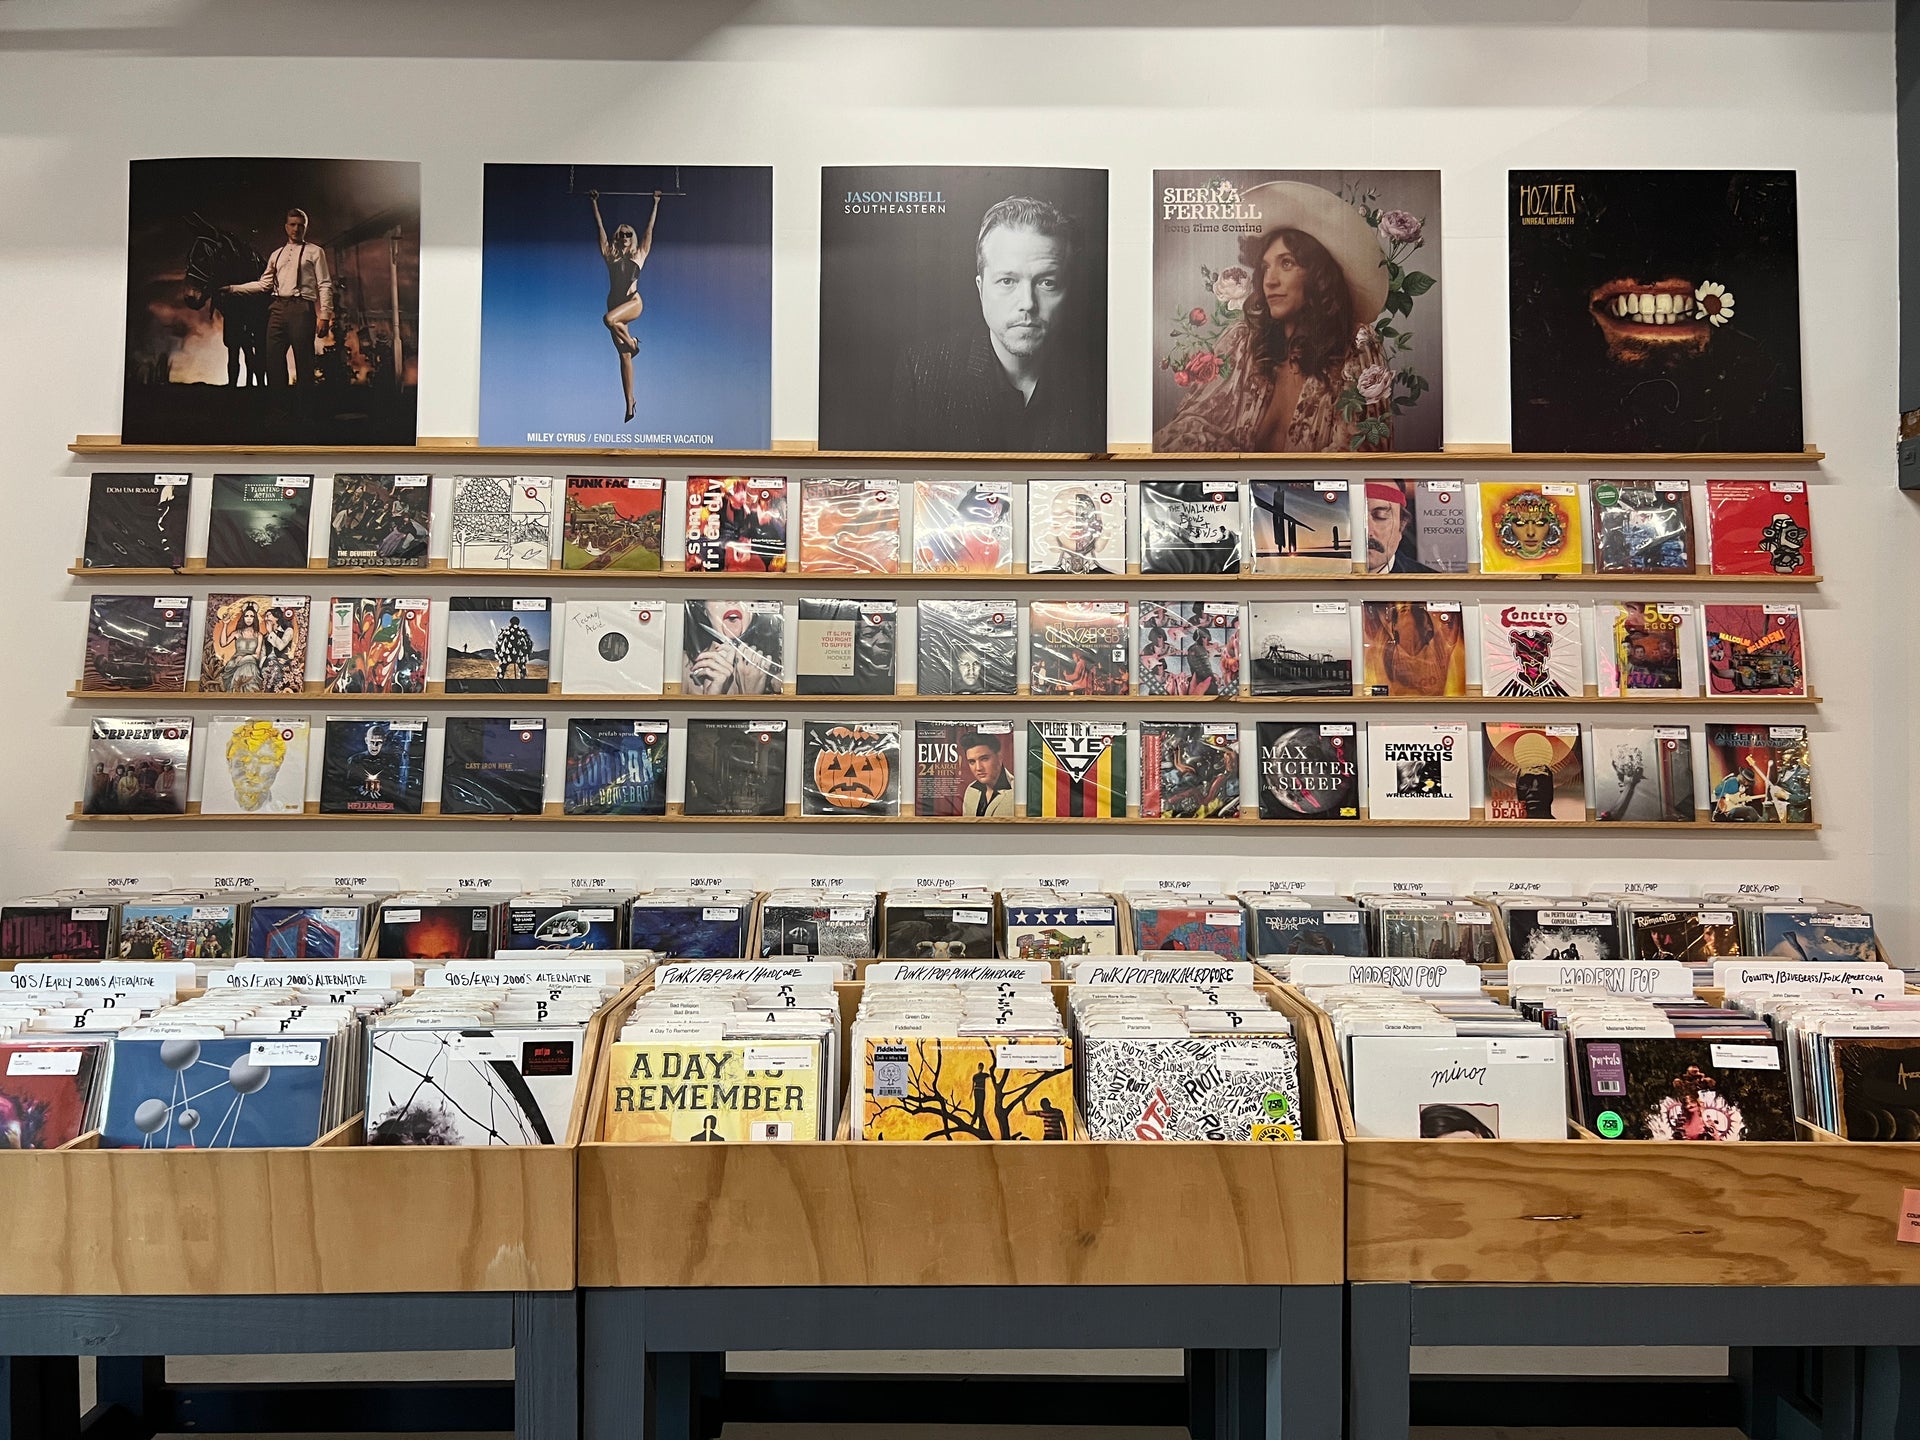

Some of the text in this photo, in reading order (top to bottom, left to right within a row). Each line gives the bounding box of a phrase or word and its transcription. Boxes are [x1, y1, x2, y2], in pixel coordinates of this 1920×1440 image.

[844, 191, 946, 203] JASON ISBELL
[1163, 187, 1241, 204] SIERRA
[1520, 184, 1576, 216] HOZIER
[844, 204, 946, 214] SOUTHEASTERN
[1163, 203, 1263, 220] FERRELL
[1522, 217, 1575, 226] UNREAL UNEARTH
[1192, 223, 1220, 233] Time
[1221, 222, 1263, 234] Coming
[527, 432, 714, 445] MILEY CYRUS ENDLESS SUMMER VACATION
[568, 478, 602, 489] FUNK
[1182, 503, 1227, 513] WALKMEN
[688, 494, 701, 554] some
[703, 479, 724, 570] friendly
[1443, 518, 1465, 526] SOLO
[1423, 527, 1465, 535] PERFORMER
[337, 550, 349, 558] THE
[336, 557, 419, 567] DISPOSABLE
[1644, 622, 1675, 630] EGGS
[1719, 632, 1751, 647] MALCOLM
[1497, 679, 1570, 697] INVASION
[1044, 722, 1068, 736] PLEASE
[1070, 721, 1083, 736] THE
[1050, 738, 1101, 752] EYE
[1385, 743, 1453, 751] EMMYLOU
[918, 743, 958, 763] ELVIS
[1262, 746, 1307, 760] MAX
[1385, 752, 1453, 762] HARRIS
[918, 764, 935, 776] 24
[1262, 761, 1356, 775] RICHTER
[1279, 777, 1343, 791] SLEEP
[347, 802, 395, 810] HELLRAISER
[1491, 800, 1527, 809] OF THE
[1491, 808, 1527, 819] DEAD
[214, 877, 254, 888] ROCK/POP
[335, 877, 367, 886] ROCK/POP
[459, 879, 492, 888] ROCK/POP
[571, 878, 606, 888] ROCK/POP
[690, 878, 722, 887] ROCK/POP
[811, 878, 844, 888] ROCK/POP
[916, 878, 955, 888] ROCK/POP
[1159, 881, 1191, 889] ROCK/POP
[1269, 881, 1306, 890] ROCK/POP
[1393, 882, 1424, 891] ROCK/POP
[1508, 882, 1541, 891] ROCK/POP
[1624, 883, 1658, 893] ROCK/POP
[1738, 884, 1780, 893] ROCK/POP
[1265, 916, 1282, 925] DON
[108, 974, 155, 988] ALTERNATIVE
[315, 973, 367, 987] ALTERNATIVE
[535, 972, 592, 984] ALTERNATIVE
[1350, 966, 1447, 988] MODERN POP
[1560, 967, 1660, 993] MODERN POP
[103, 997, 116, 1008] D
[330, 994, 346, 1003] M
[785, 996, 796, 1007] R
[1208, 994, 1218, 1006] S
[73, 1015, 86, 1029] B
[537, 1010, 549, 1022] P
[766, 1012, 776, 1023] A
[1231, 1016, 1243, 1028] P
[279, 1019, 291, 1033] F
[1121, 1041, 1145, 1059] RIOT!
[304, 1054, 317, 1063] $30
[1590, 1053, 1621, 1068] portals
[630, 1053, 653, 1079] A
[661, 1052, 732, 1080] DAY
[1431, 1059, 1487, 1088] minor
[1107, 1067, 1130, 1101] RIOT!
[1125, 1077, 1150, 1095] RIOT!
[1184, 1063, 1225, 1105] RIOT!
[614, 1084, 804, 1112] REMEMBER
[1257, 1127, 1289, 1140] FUELED BY
